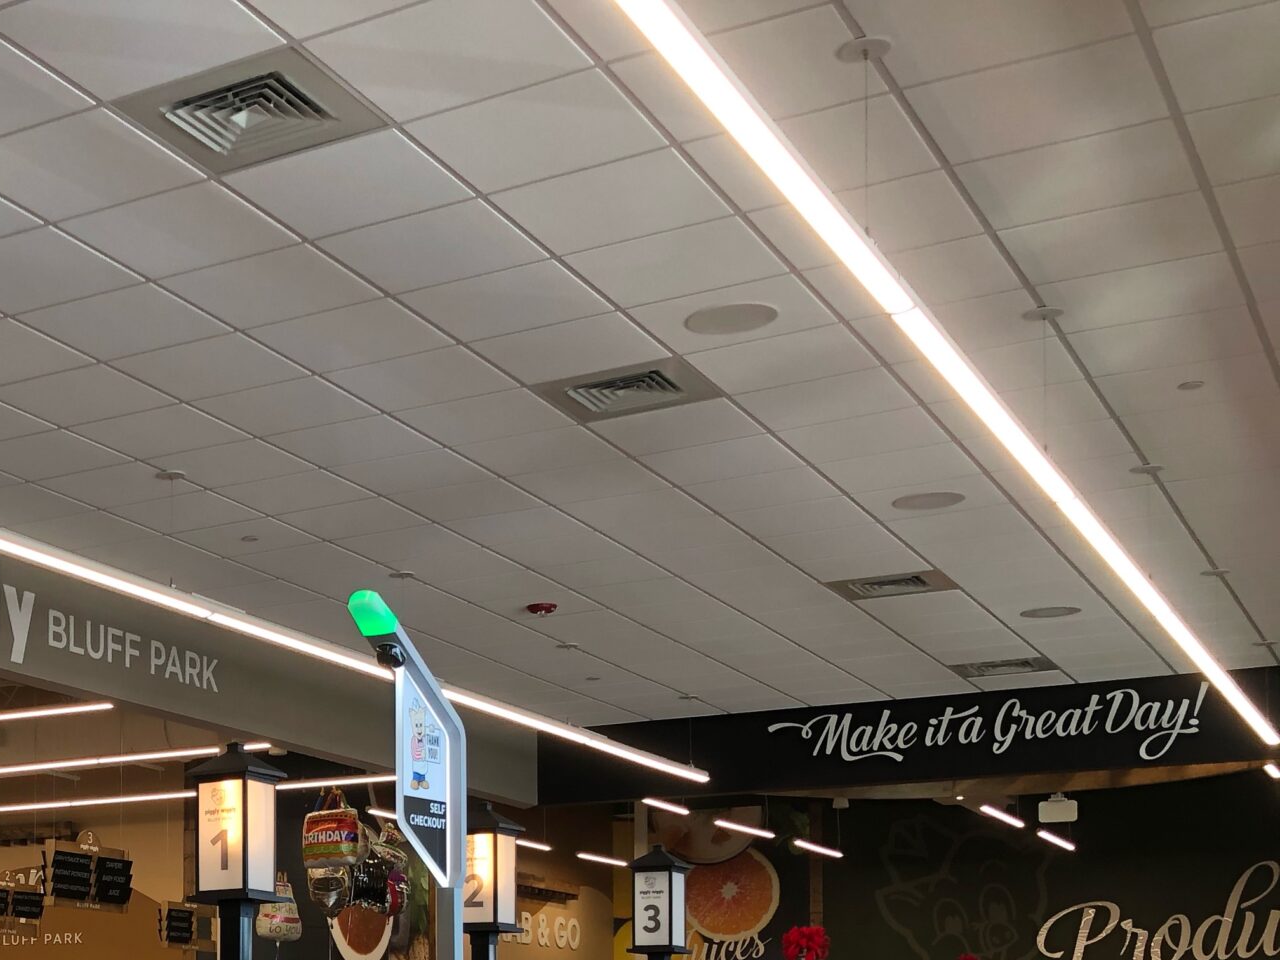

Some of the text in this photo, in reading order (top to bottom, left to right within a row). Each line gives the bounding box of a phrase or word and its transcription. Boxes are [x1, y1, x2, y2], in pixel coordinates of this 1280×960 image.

[48, 609, 142, 668] BLUFF
[149, 645, 219, 693] PARK
[768, 682, 1210, 762] Make it a Great Day!
[410, 813, 446, 829] CHECKOUT
[429, 802, 446, 815] SELF
[87, 831, 93, 844] 3
[210, 829, 228, 871] 1
[304, 830, 348, 844] IRTHDAY
[464, 874, 484, 907] 2
[537, 913, 550, 947] &
[554, 916, 580, 951] GO
[642, 904, 661, 933] 3
[44, 931, 83, 945] PARK
